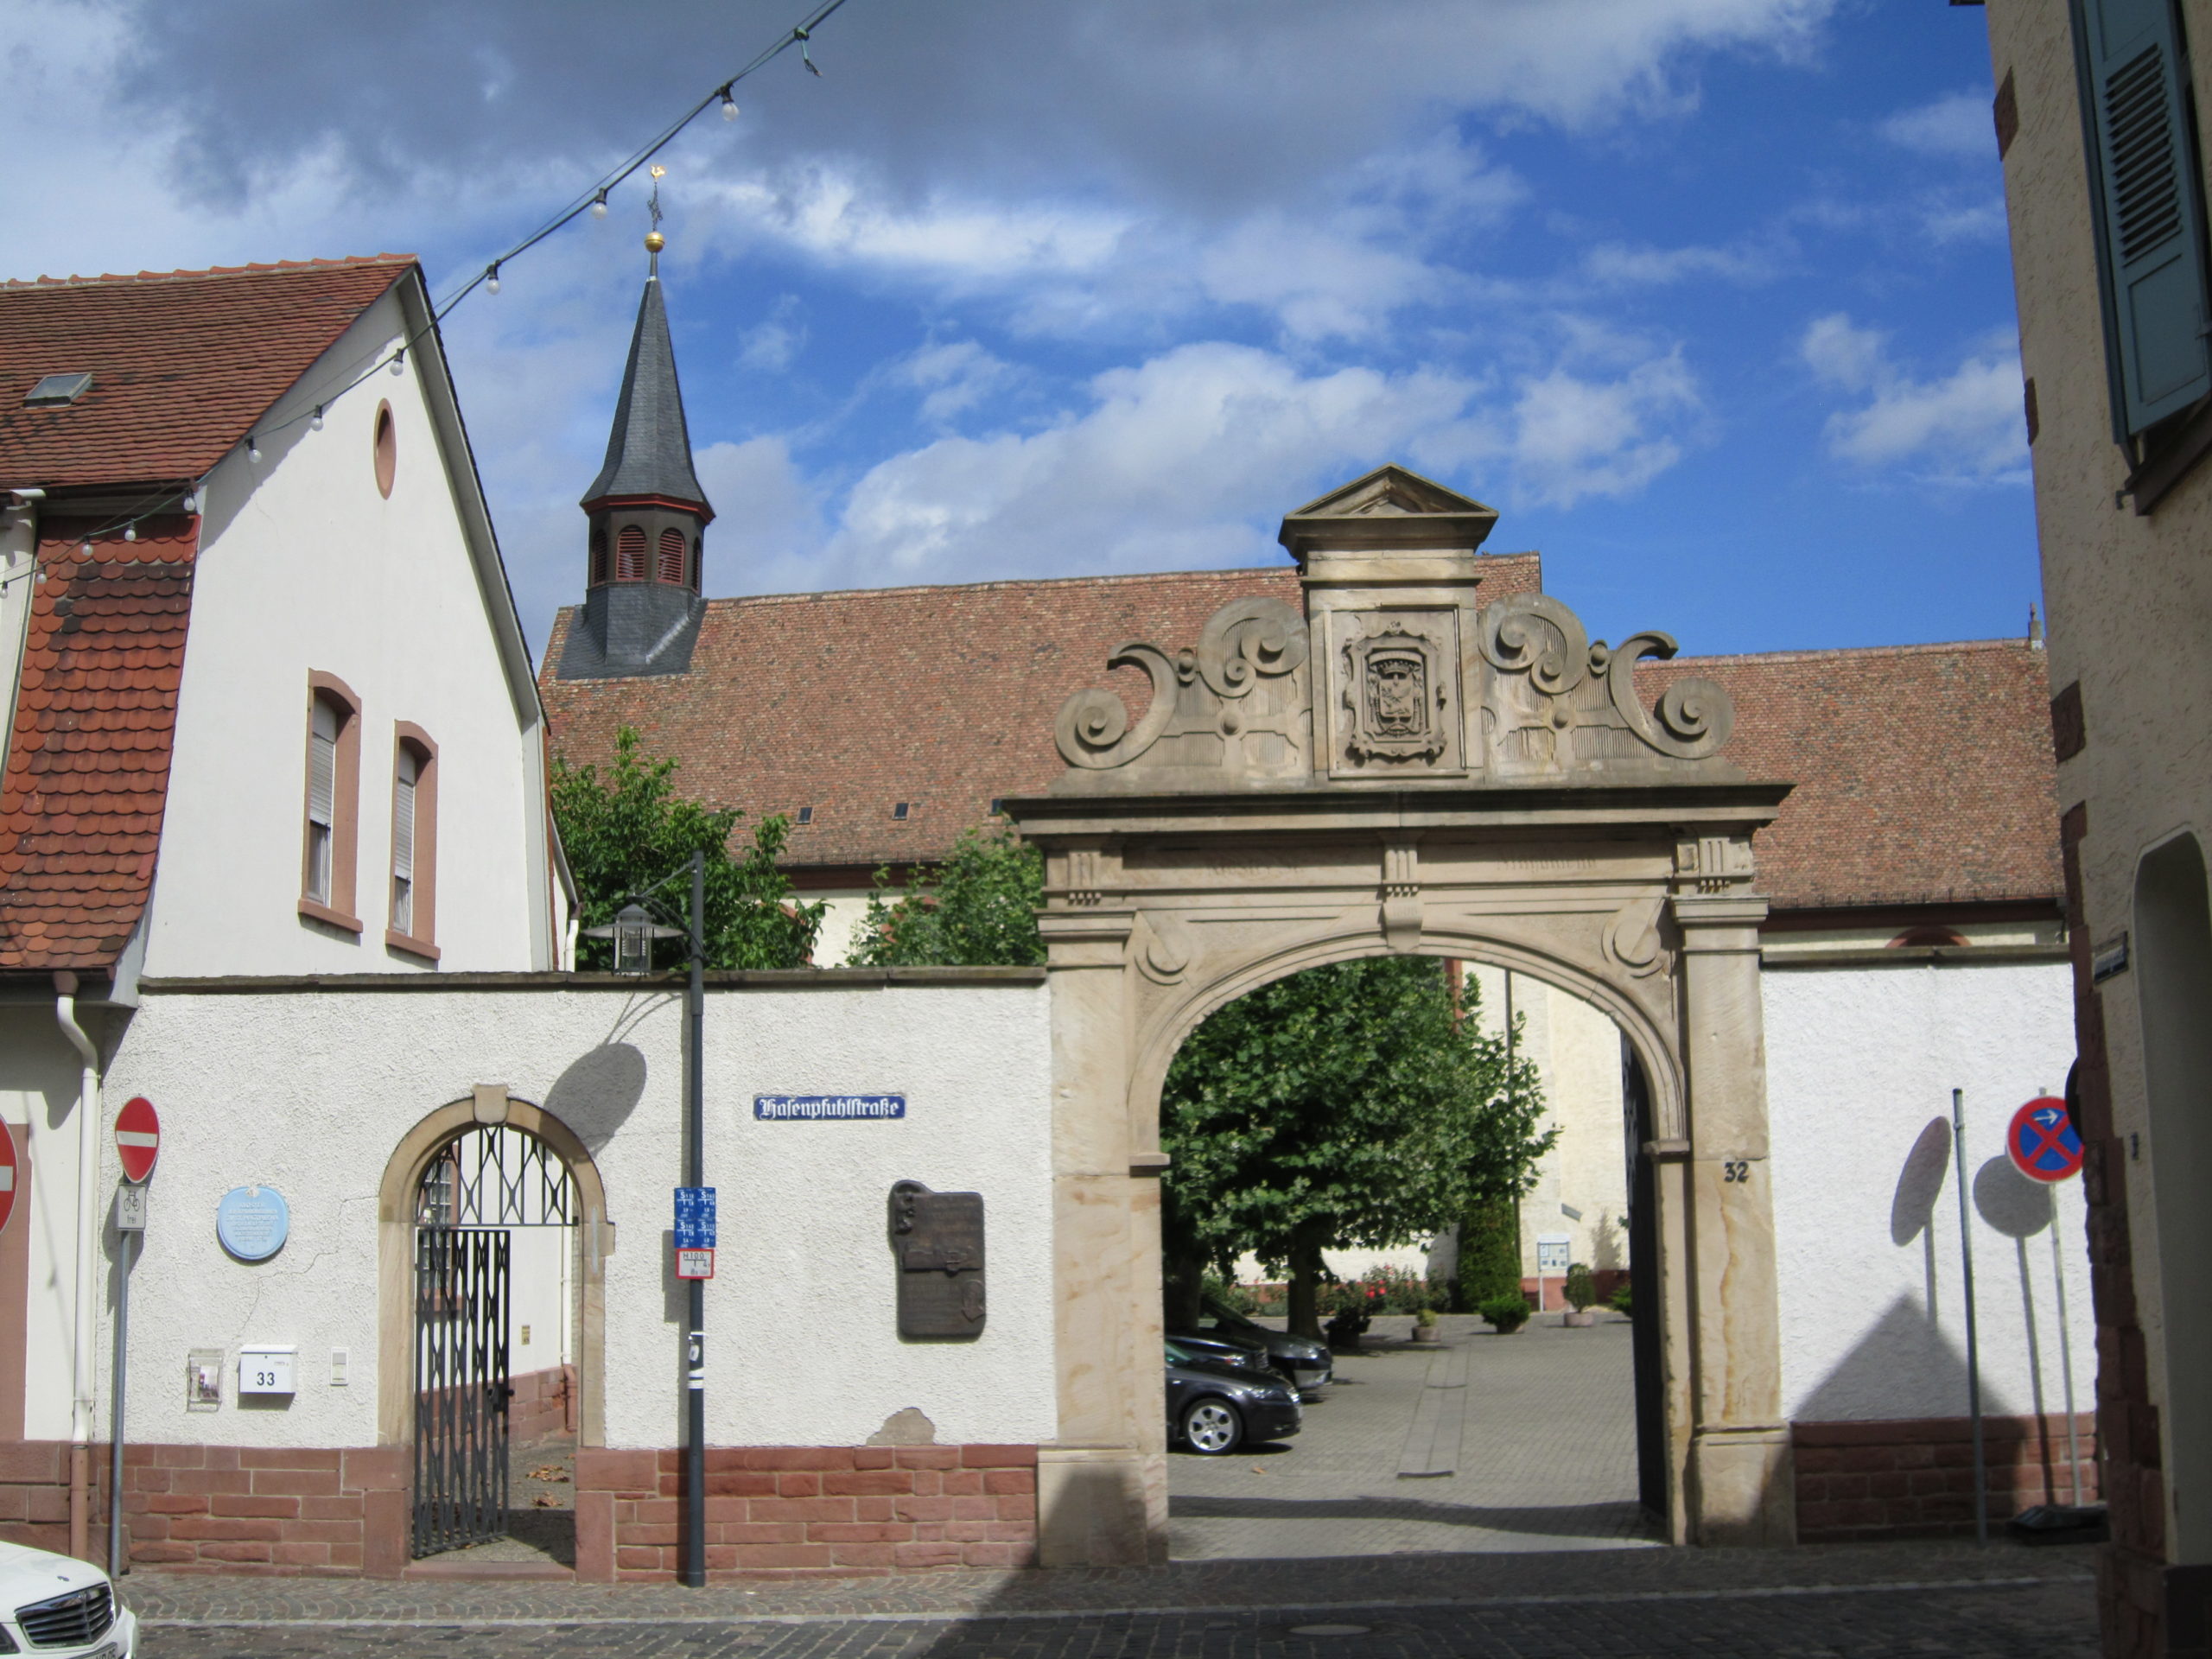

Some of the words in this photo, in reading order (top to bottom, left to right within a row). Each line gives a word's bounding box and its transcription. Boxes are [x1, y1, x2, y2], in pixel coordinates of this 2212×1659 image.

[759, 1097, 899, 1121] Hasenpfuhlstraße
[1724, 1161, 1749, 1183] 32
[257, 1372, 275, 1386] 33
